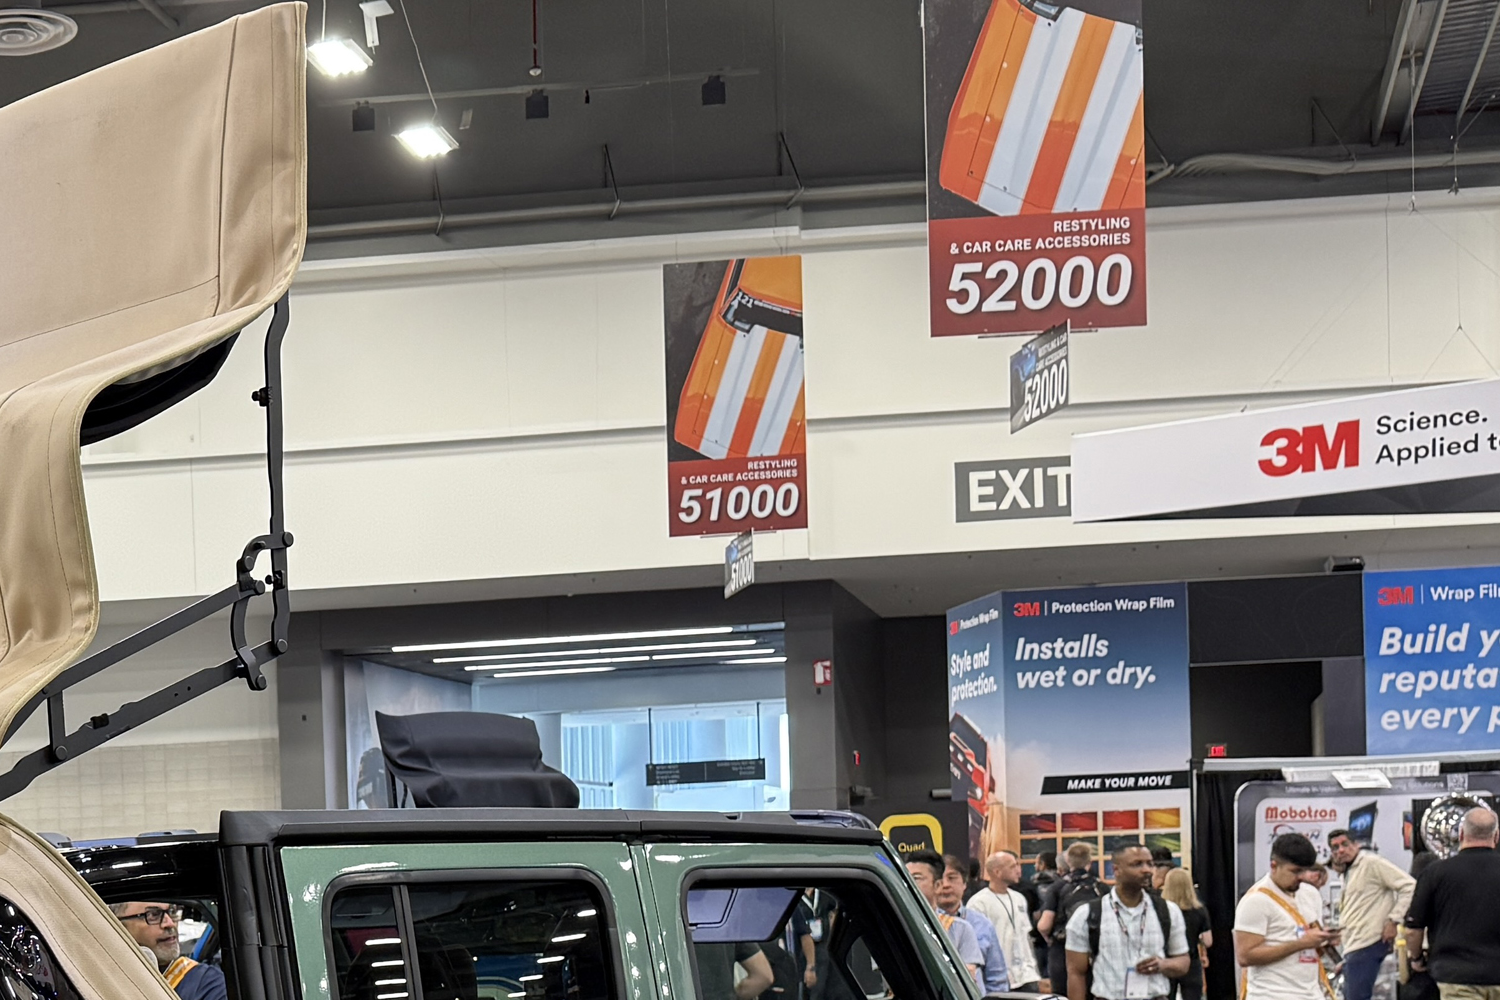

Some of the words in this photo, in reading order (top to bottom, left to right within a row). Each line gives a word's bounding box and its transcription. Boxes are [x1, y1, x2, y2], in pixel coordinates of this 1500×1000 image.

[1053, 216, 1130, 233] RESTYLING
[949, 243, 959, 254] &
[963, 242, 991, 253] CAR
[995, 239, 1032, 251] CARE
[1035, 233, 1130, 249] ACCESSORIES
[946, 253, 1132, 314] 52000
[1024, 358, 1068, 423] 52000
[1258, 419, 1360, 476] 3M
[1376, 407, 1489, 436] Science.
[1376, 431, 1479, 467] Applied
[681, 476, 688, 485] &
[690, 475, 708, 484] CAR
[710, 473, 734, 483] CARE
[736, 468, 798, 481] ACCESSORIES
[747, 458, 798, 469] RESTYLING
[678, 482, 800, 524] 51000
[968, 464, 1072, 514] EXIT
[1014, 601, 1041, 617] 3M
[1052, 600, 1112, 614] Protection
[1115, 598, 1146, 612] Wrap
[1150, 597, 1175, 608] Film
[1378, 586, 1414, 606] 3M
[1430, 586, 1475, 603] Wrap
[1015, 633, 1109, 661] Installs
[1379, 622, 1470, 656] Build
[1478, 629, 1500, 658] y
[951, 649, 972, 679] Style
[973, 642, 990, 670] and
[1017, 665, 1067, 689] wet
[1072, 667, 1101, 687] or
[1106, 660, 1156, 689] dry.
[951, 672, 998, 708] protection.
[1379, 663, 1500, 699] reputa
[1380, 706, 1481, 735] every
[1067, 778, 1101, 790] MAKE
[1104, 777, 1135, 788] YOUR
[1137, 775, 1173, 786] MOVE
[1265, 806, 1337, 819] Mobotron
